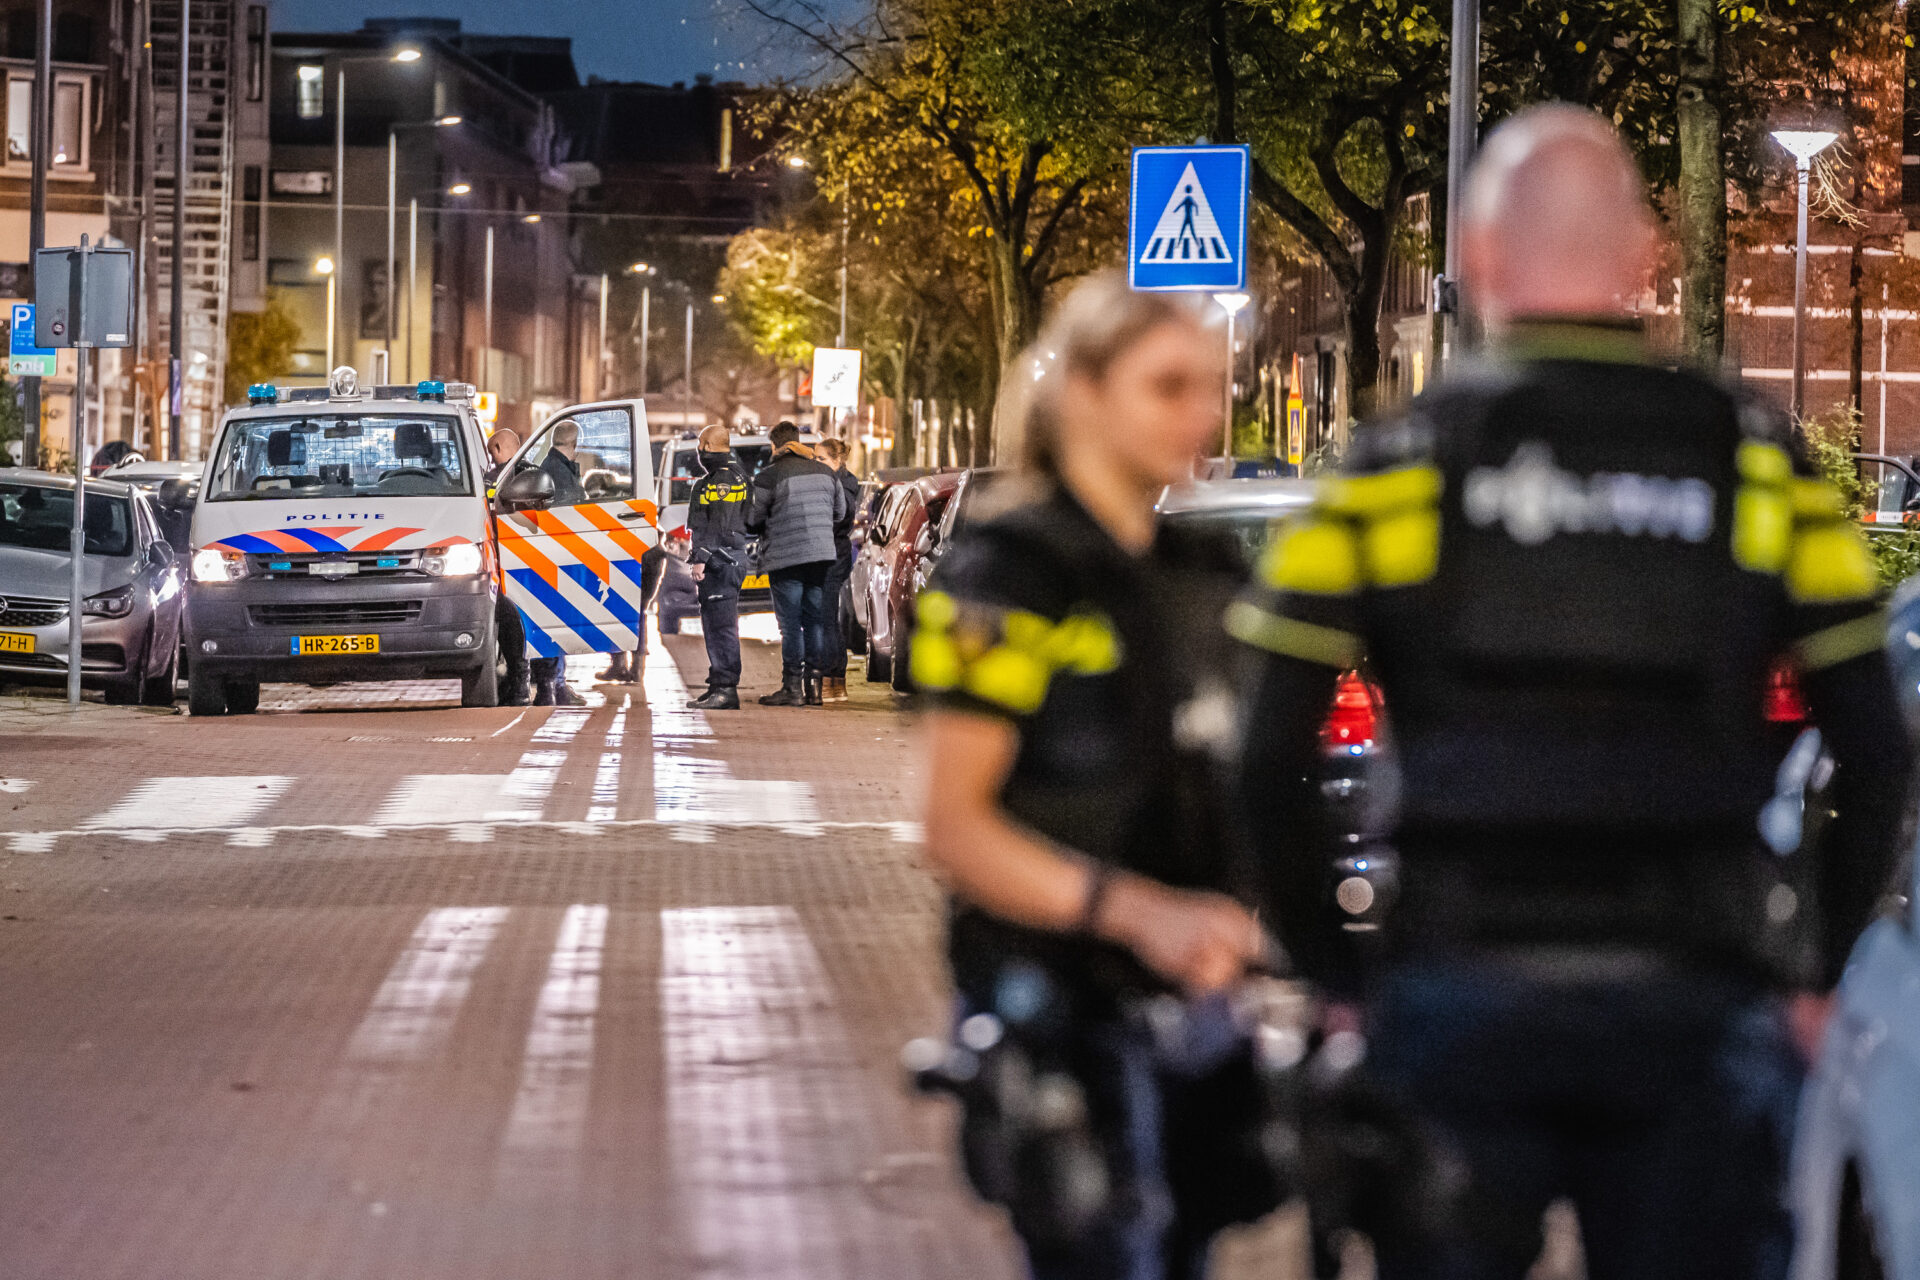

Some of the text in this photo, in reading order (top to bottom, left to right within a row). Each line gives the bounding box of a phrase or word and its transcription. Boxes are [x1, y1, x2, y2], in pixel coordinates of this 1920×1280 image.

[14, 306, 31, 330] P
[286, 513, 385, 521] POLITIE
[304, 637, 375, 652] HR-265-B
